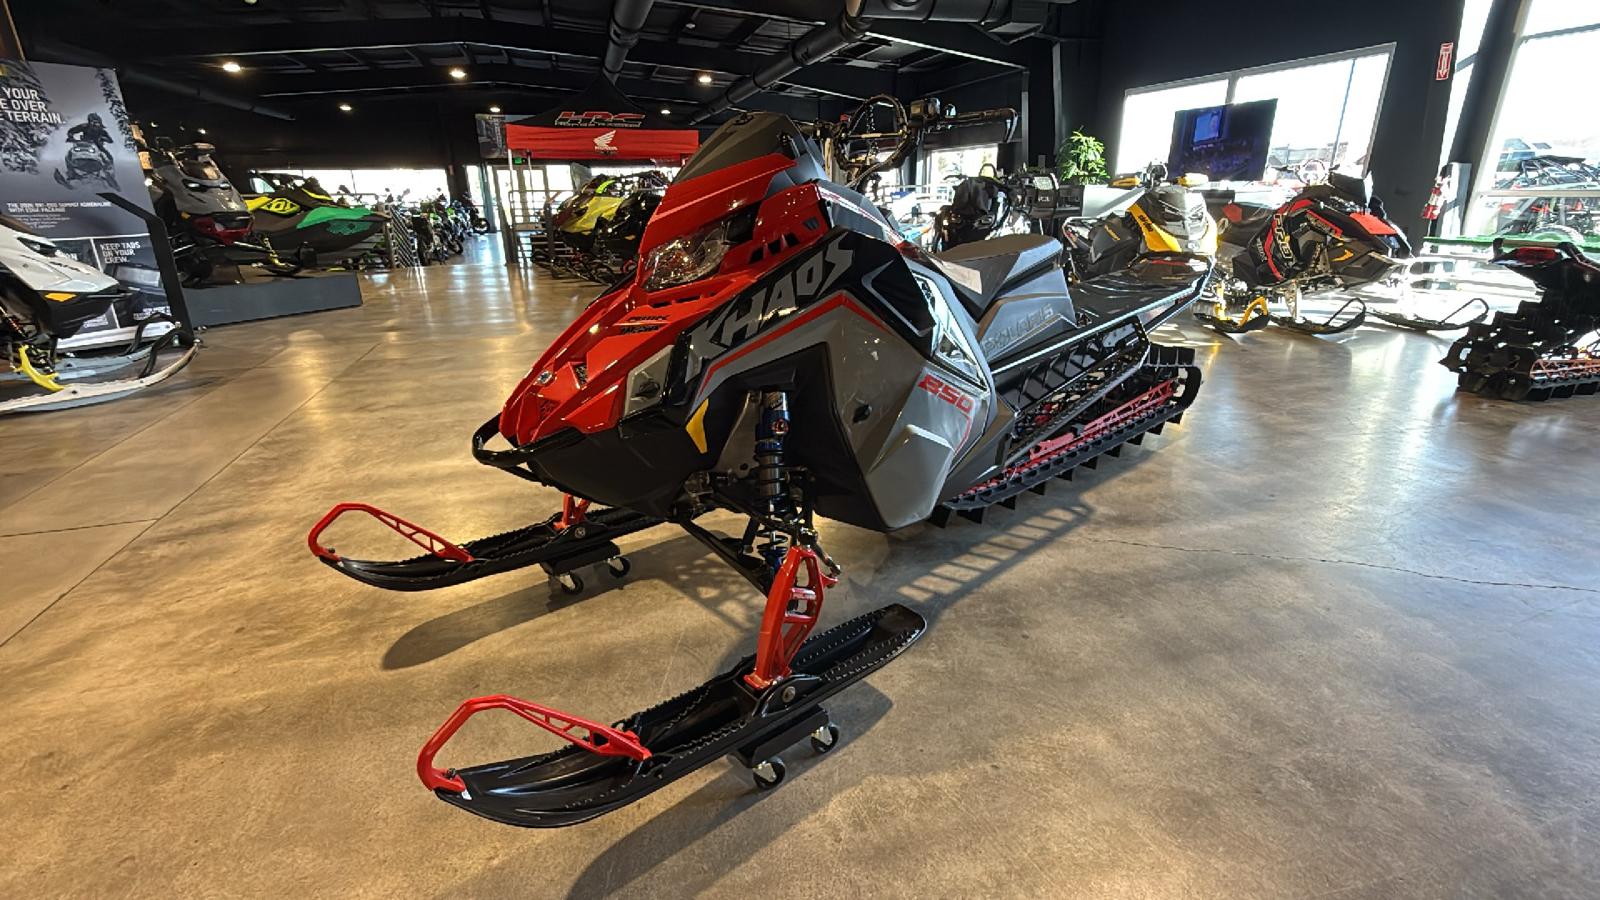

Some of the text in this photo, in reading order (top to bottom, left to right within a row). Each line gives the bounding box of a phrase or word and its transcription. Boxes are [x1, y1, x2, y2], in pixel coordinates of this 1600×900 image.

[2, 86, 40, 100] YOUR
[11, 99, 48, 112] OVER
[5, 110, 66, 124] TERRAIN.
[100, 241, 141, 251] KEEP TABS
[104, 256, 130, 264] CREW.
[685, 231, 853, 383] KHAOS
[981, 303, 1054, 358] POLARIS
[918, 373, 974, 414] 850
